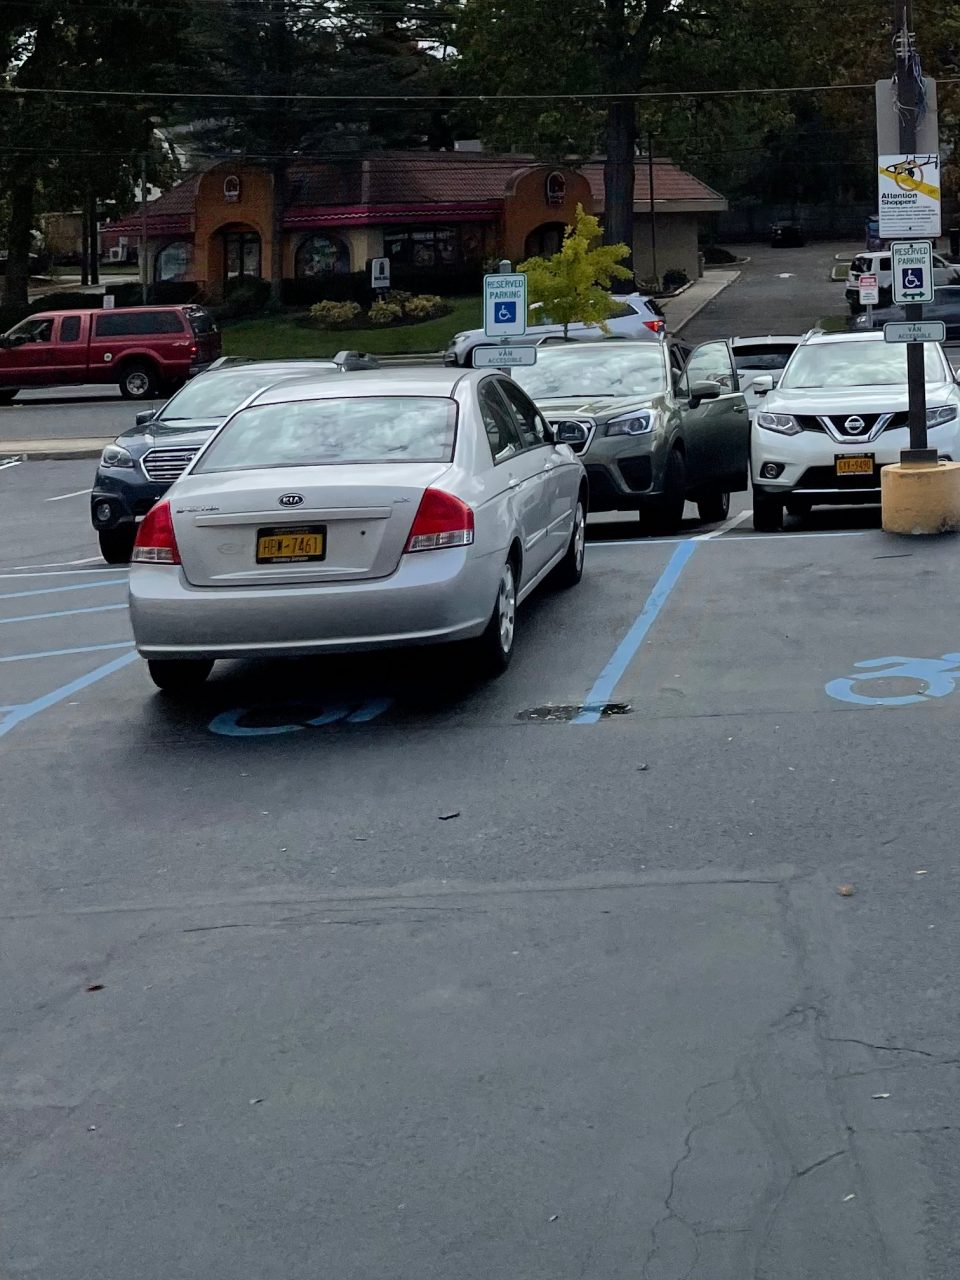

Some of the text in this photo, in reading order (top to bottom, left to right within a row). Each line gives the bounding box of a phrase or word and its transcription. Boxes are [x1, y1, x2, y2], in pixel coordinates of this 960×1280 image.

[894, 246, 928, 256] RESERVED
[897, 257, 926, 265] PARKING
[487, 280, 524, 289] RESERVED
[489, 290, 521, 299] PARKING
[499, 349, 513, 357] VAN
[282, 496, 301, 504] KIA
